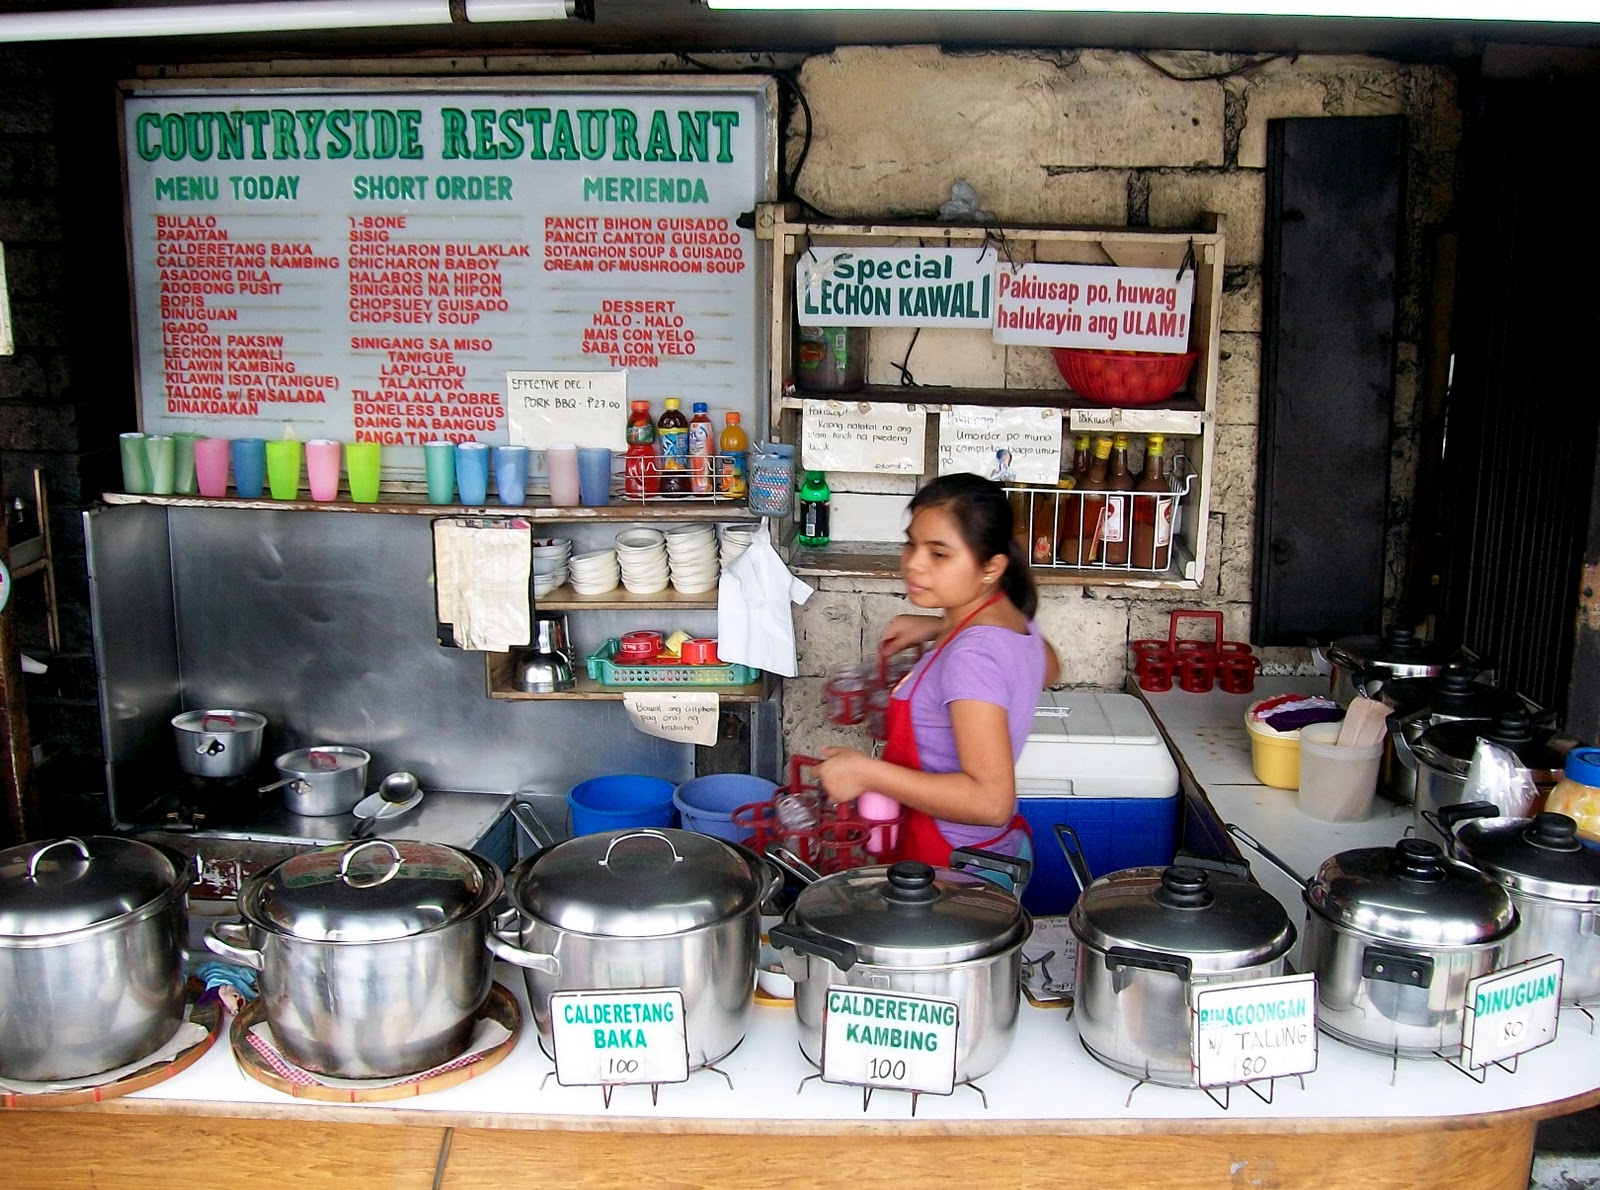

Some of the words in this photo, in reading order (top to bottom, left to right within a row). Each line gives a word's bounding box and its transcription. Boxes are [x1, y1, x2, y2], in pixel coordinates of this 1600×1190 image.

[136, 109, 424, 161] COUNTRYSIDE
[441, 107, 740, 163] RESTAURANT
[155, 176, 218, 201] MENU
[229, 176, 300, 200] TODAY
[353, 175, 429, 200] SHORT
[436, 176, 513, 200] ORDER
[583, 177, 709, 203] MERIENDA
[157, 216, 216, 228] BULALO
[544, 217, 599, 230] PANCIT
[604, 218, 652, 230] BIHON
[657, 219, 728, 231] GUISADO
[157, 230, 227, 241] PAPAITAN
[349, 231, 389, 242] SISIG
[545, 232, 598, 243] PANCIT
[603, 232, 665, 245] CANTON
[672, 233, 740, 245] GUISADO
[157, 243, 266, 255] CALDERETANG
[271, 244, 312, 255] BAKA
[349, 244, 440, 256] CHICHARON
[445, 245, 530, 257] BULAKLAK
[544, 246, 625, 258] SOTANGHON
[630, 247, 665, 259] SOUP
[669, 248, 678, 258] &
[682, 248, 743, 260] GUISADO
[157, 257, 265, 268] CALDERETANG
[270, 257, 339, 269] KAMBING
[348, 258, 439, 269] CHICHARON
[444, 258, 499, 270] BABOY
[544, 260, 594, 271] CREAM
[598, 260, 617, 271] OF
[619, 260, 702, 273] MUSHROOM
[706, 261, 745, 273] SOUP
[833, 253, 952, 285] Special
[160, 270, 232, 281] ASADONG
[237, 271, 270, 281] DILA
[350, 272, 422, 283] HALABOS
[428, 273, 449, 283] NA
[454, 273, 502, 284] HIPON
[160, 283, 234, 294] ADOBONG
[240, 283, 282, 295] PUSIT
[349, 284, 423, 296] SINIGANG
[428, 285, 449, 296] NA
[454, 285, 502, 297] HIPON
[804, 271, 891, 316] LECHON
[900, 274, 990, 318] KAWALI
[1000, 273, 1079, 304] Pakiusap
[1086, 284, 1111, 305] po,
[1116, 279, 1176, 311] huwag
[161, 296, 204, 307] BOPIS
[349, 298, 432, 310] CHOPSUEY
[438, 299, 508, 311] GUISADO
[602, 301, 675, 313] DESSERT
[162, 309, 237, 320] DINUGUAN
[350, 311, 433, 323] CHOPSUEY
[438, 313, 480, 324] SOUP
[593, 314, 631, 326] HALO
[645, 316, 683, 328] HALO
[163, 323, 208, 333] IGADO
[998, 305, 1082, 335] halukayin
[1088, 315, 1118, 340] ang
[1123, 310, 1186, 338] ULAM!
[163, 335, 221, 346] LECHON
[228, 336, 283, 347] PAKSIW
[584, 329, 617, 340] MAIS
[623, 329, 653, 341] CON
[657, 330, 694, 342] YELO
[351, 338, 424, 349] SINIGANG
[429, 338, 449, 350] SA
[454, 339, 492, 351] MISO
[582, 342, 619, 354] SABA
[624, 343, 653, 354] CON
[658, 343, 695, 355] YELO
[164, 348, 222, 359] LECHON
[227, 348, 282, 360] KAWALI
[388, 351, 453, 364] TANIGUE
[165, 360, 222, 371] KILAWIN
[228, 361, 295, 373] KAMBING
[609, 356, 659, 367] TURON
[381, 364, 466, 377] LAPU-LAPU
[166, 373, 223, 385] KILAWIN
[229, 374, 262, 386] ISDA
[266, 375, 339, 390] (TANIGUE)
[379, 377, 464, 389] TALAKITOK
[166, 386, 222, 400] TALONG
[227, 388, 242, 400] w/
[247, 389, 325, 403] ENSALADA
[352, 390, 409, 402] TILAPIA
[412, 392, 442, 403] ALA
[447, 393, 500, 404] POBRE
[168, 400, 258, 415] DINAKDAKAN
[524, 397, 550, 408] PORK
[555, 398, 576, 408] BBQ
[353, 404, 434, 416] BONELESS
[439, 406, 504, 418] BANGUS
[355, 417, 401, 428] DAING
[406, 419, 427, 429] NA
[432, 419, 496, 431] BANGUS
[419, 432, 438, 444] NA
[444, 432, 476, 443] ISDA
[1475, 973, 1556, 1017] DINUGUAN
[564, 1002, 674, 1024] CALDERETANG
[830, 993, 954, 1026] CALDERETANG
[594, 1029, 647, 1048] BAKA
[846, 1023, 937, 1052] KAMBING
[610, 1059, 638, 1074] 100
[870, 1058, 906, 1080] 100
[1242, 1056, 1266, 1076] 80
